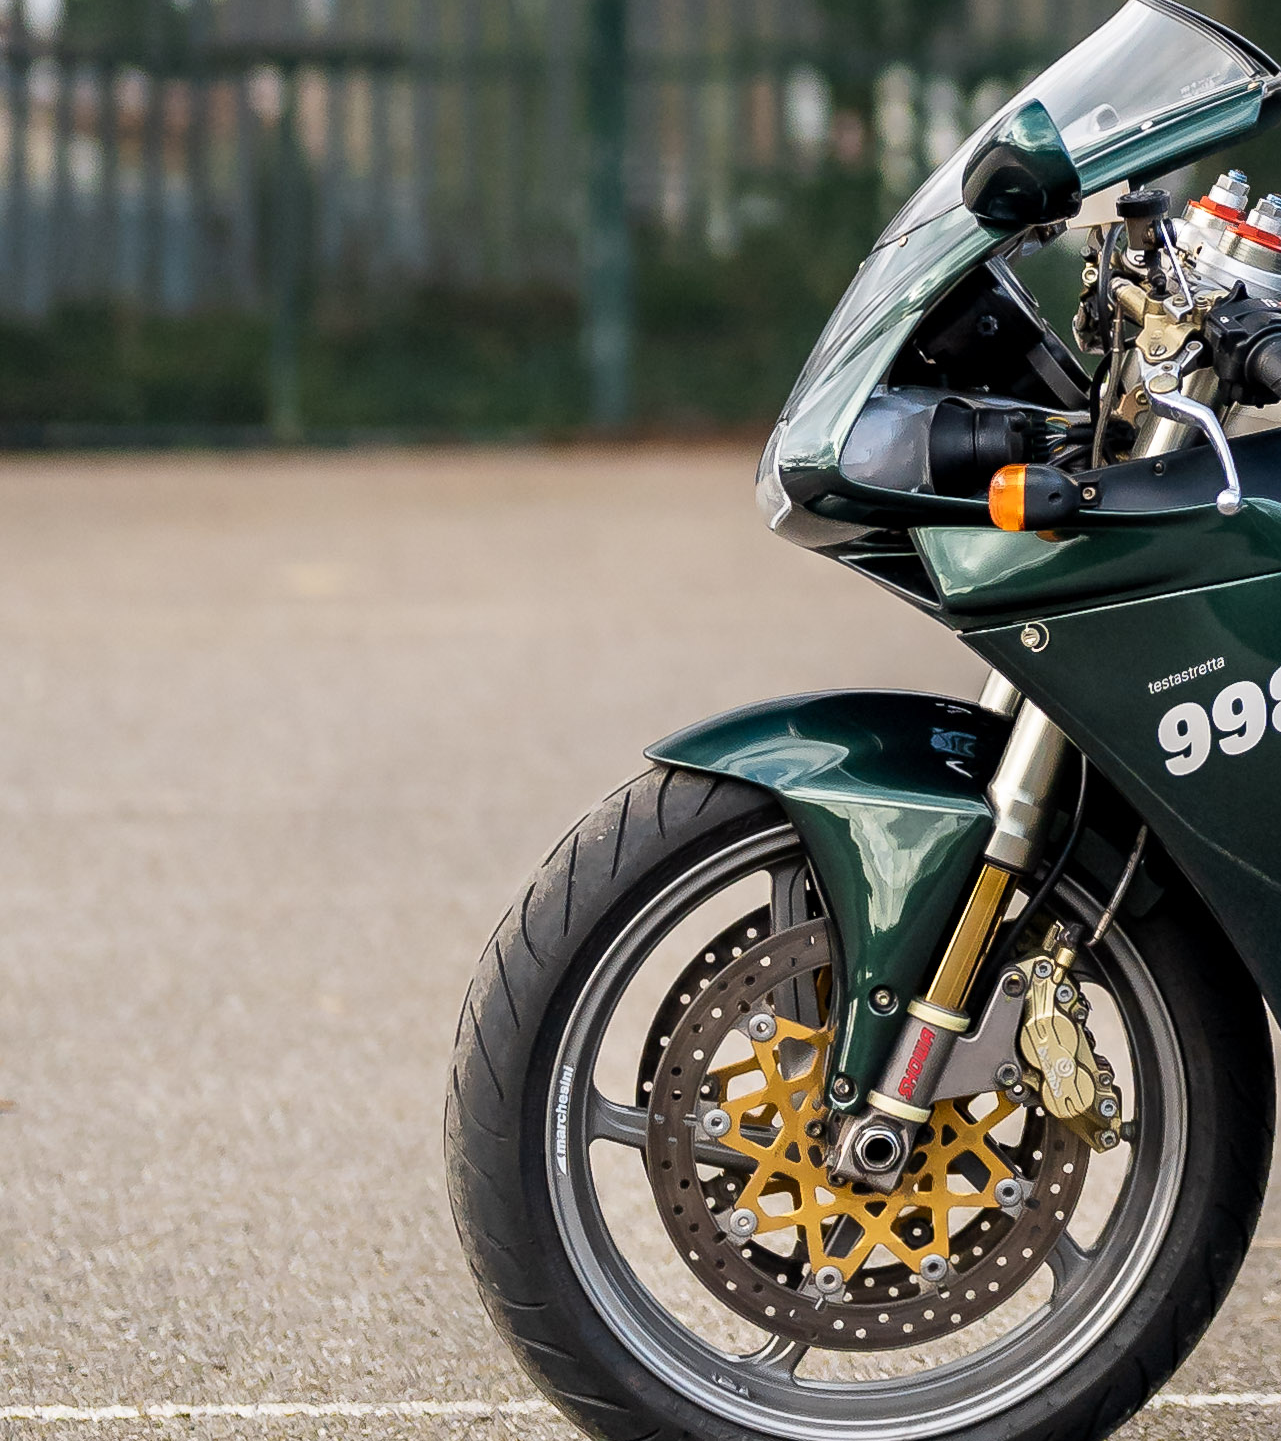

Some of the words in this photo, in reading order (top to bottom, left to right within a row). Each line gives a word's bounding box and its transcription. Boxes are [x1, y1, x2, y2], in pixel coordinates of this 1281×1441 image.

[1148, 656, 1226, 695] testastretta
[898, 1026, 936, 1101] SHOWA
[555, 1064, 575, 1154] marchesini
